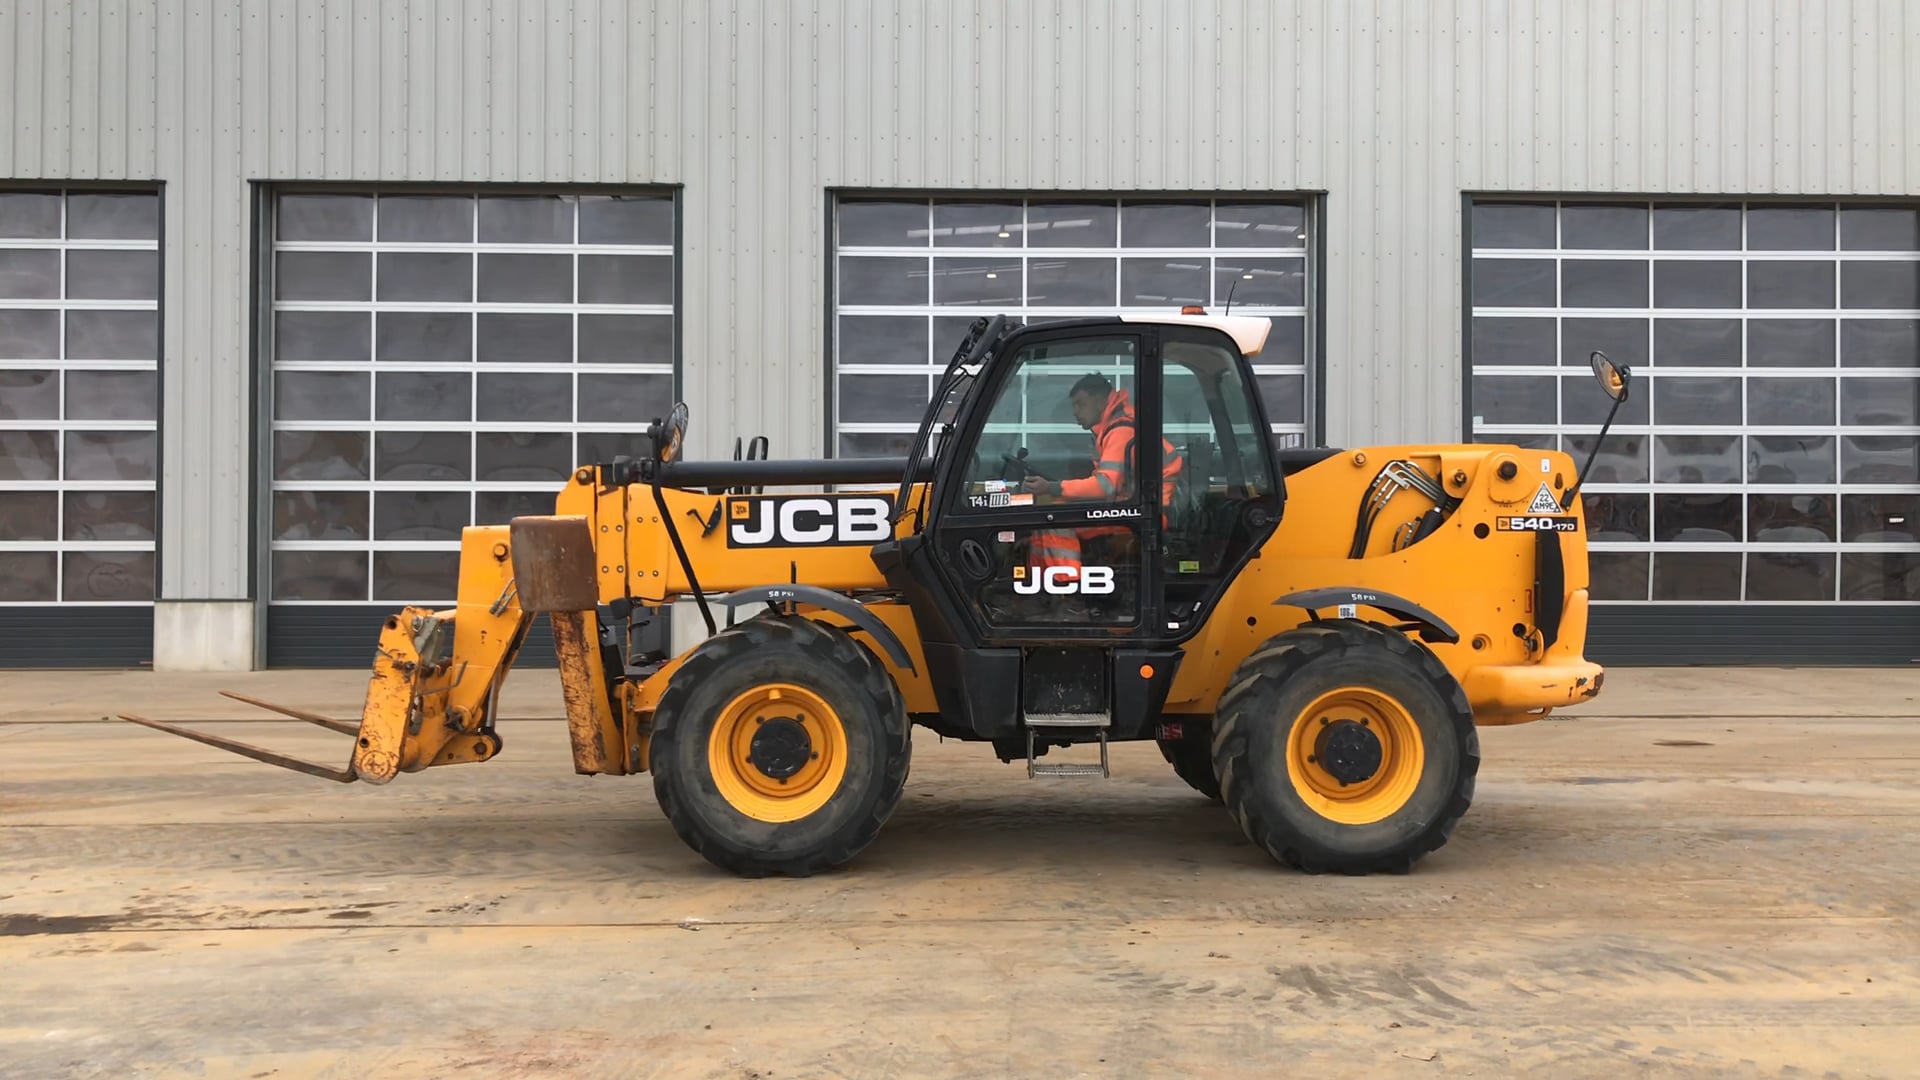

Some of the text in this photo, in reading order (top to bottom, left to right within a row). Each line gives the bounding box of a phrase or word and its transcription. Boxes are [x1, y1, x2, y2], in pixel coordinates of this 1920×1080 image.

[968, 495, 989, 508] T4i
[1539, 494, 1550, 502] 22
[1086, 508, 1142, 519] LOADALL
[731, 499, 891, 544] JCB
[1013, 566, 1116, 595] JCB
